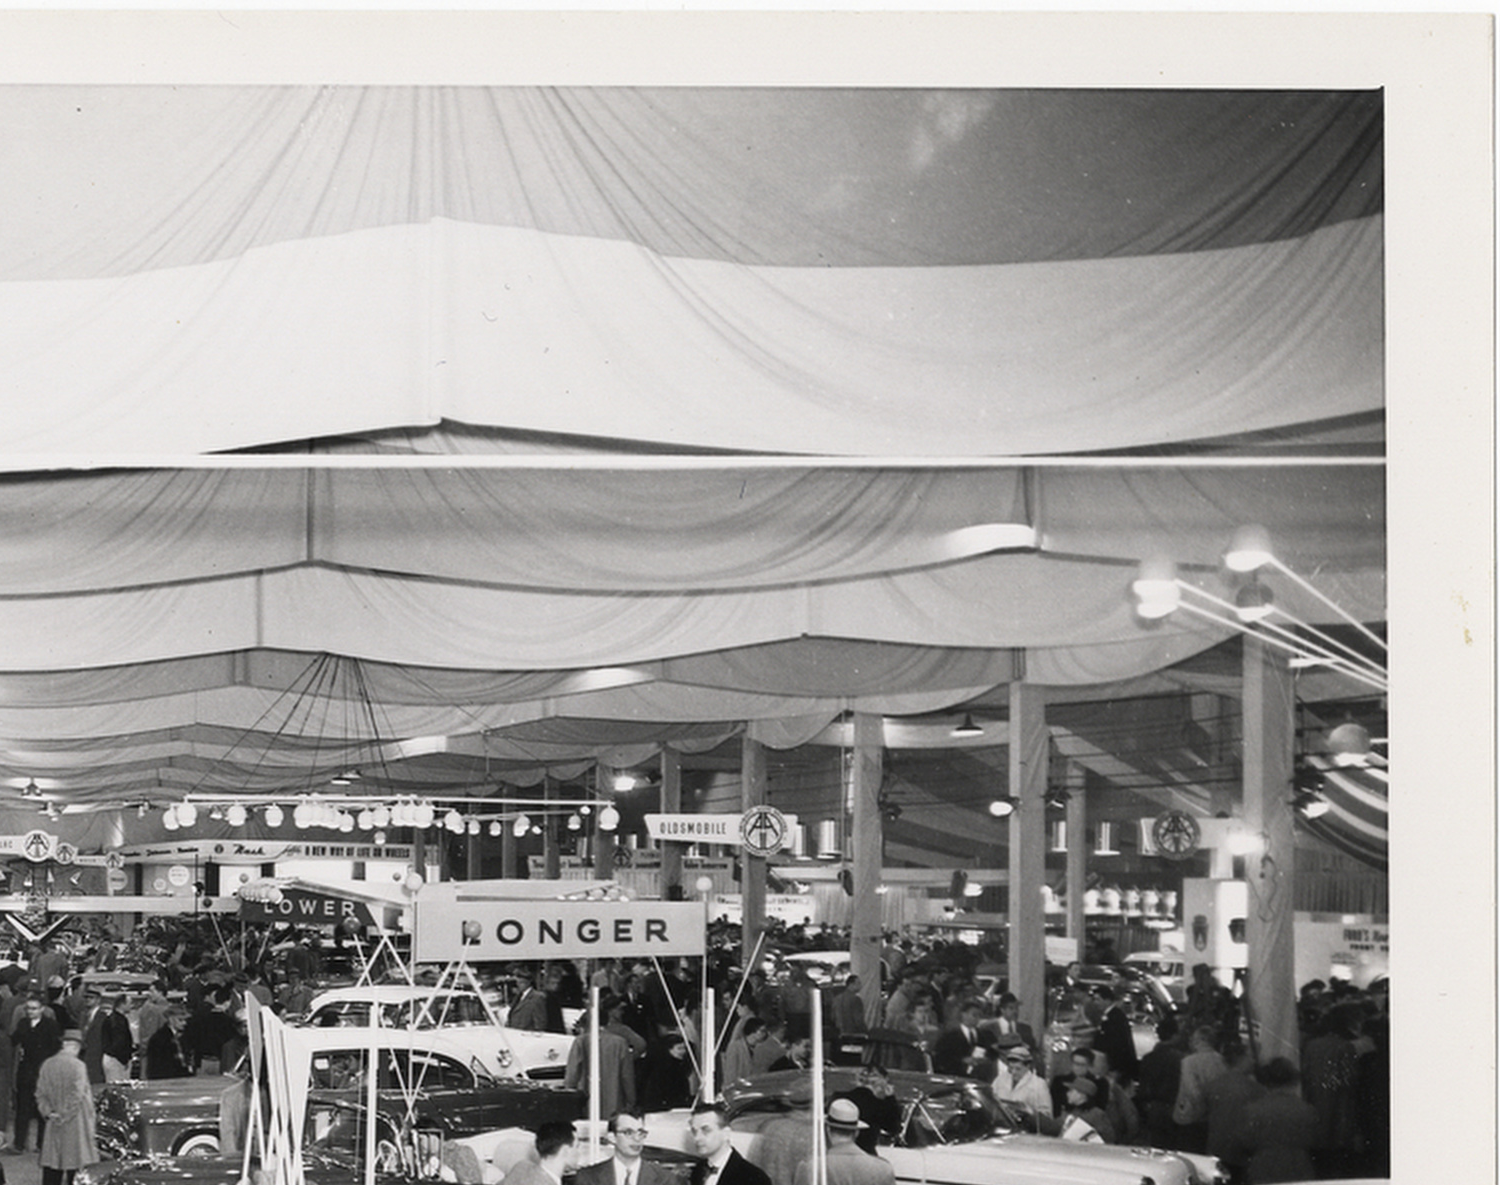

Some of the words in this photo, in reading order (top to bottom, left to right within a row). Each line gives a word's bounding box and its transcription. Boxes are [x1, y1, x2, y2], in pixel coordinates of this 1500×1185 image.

[659, 822, 726, 835] OLDSMOBILE
[233, 843, 266, 855] Nash
[330, 846, 344, 857] WAY
[346, 847, 355, 857] OF
[356, 847, 371, 858] LIFE
[385, 847, 410, 858] WHEELS
[264, 899, 355, 916] LOWER
[461, 919, 669, 946] LONGER
